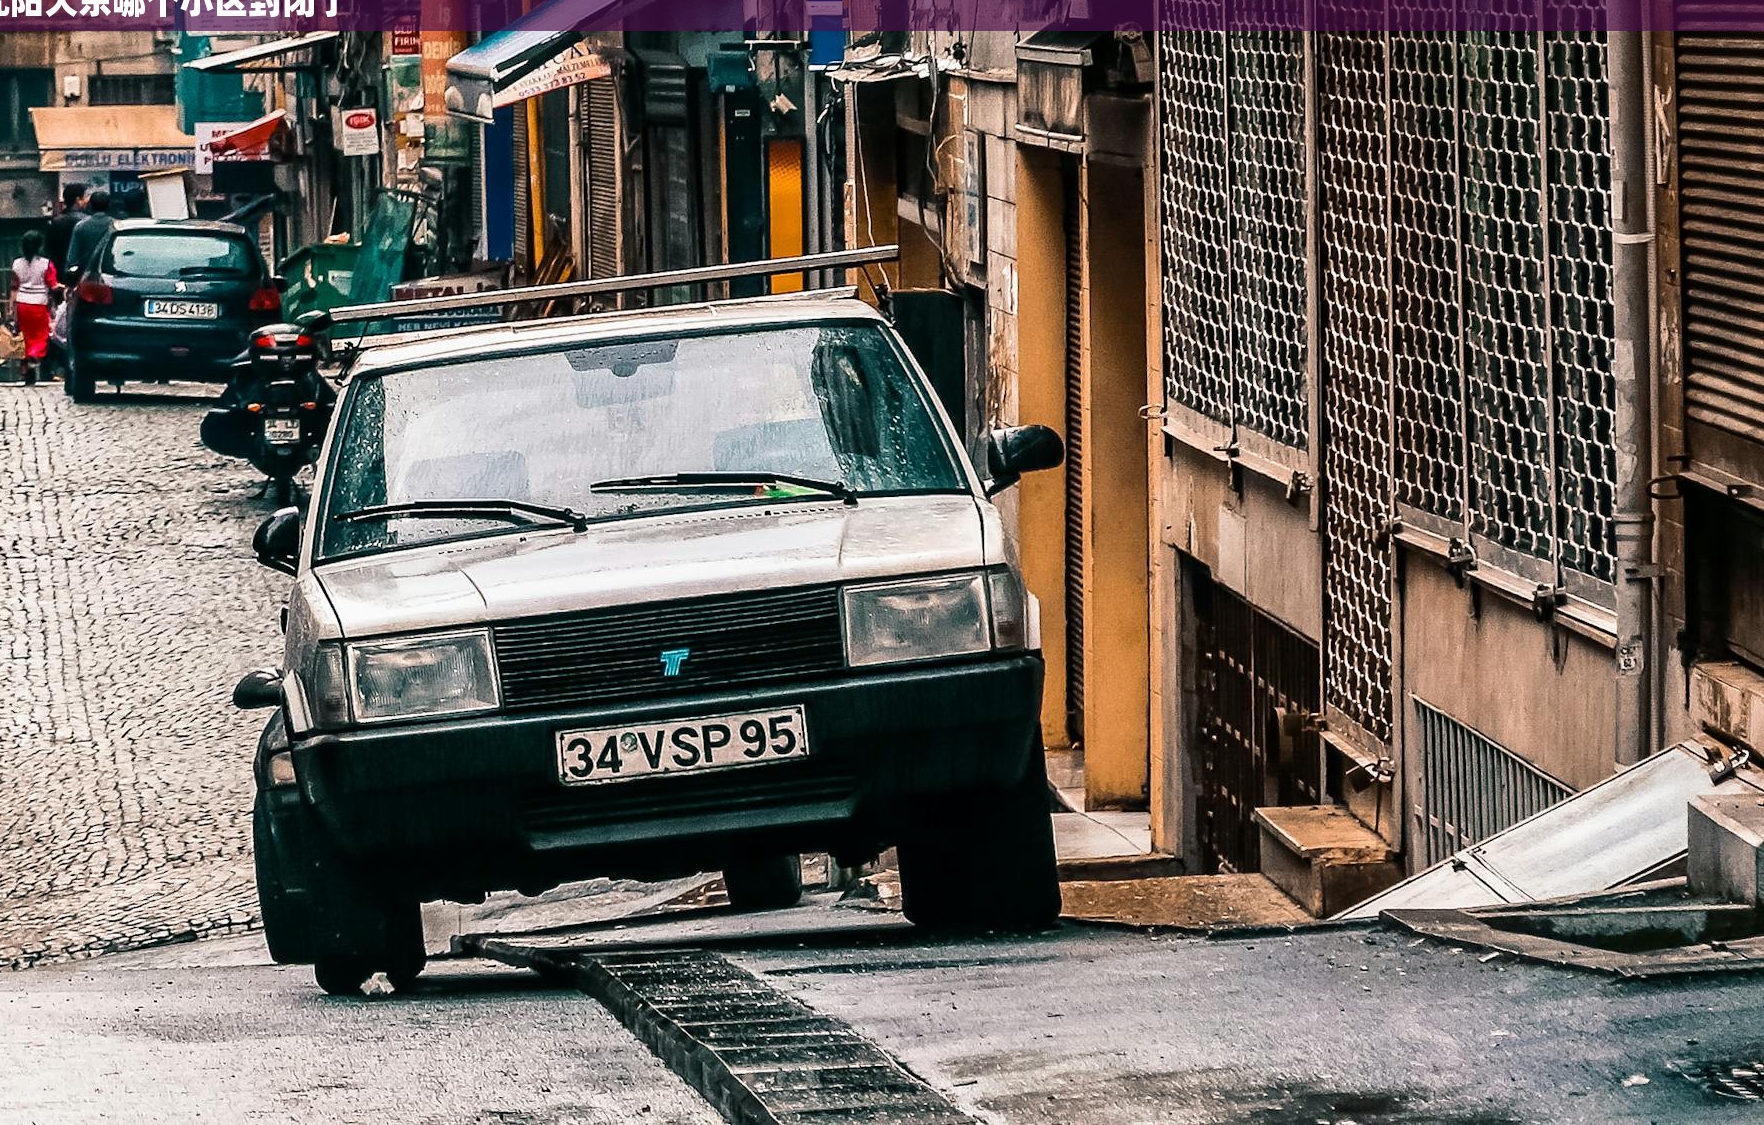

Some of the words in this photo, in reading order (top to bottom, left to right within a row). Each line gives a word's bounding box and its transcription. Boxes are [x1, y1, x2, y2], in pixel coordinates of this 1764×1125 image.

[566, 735, 623, 777] 34
[637, 722, 732, 770] VSP
[739, 714, 797, 759] 95
